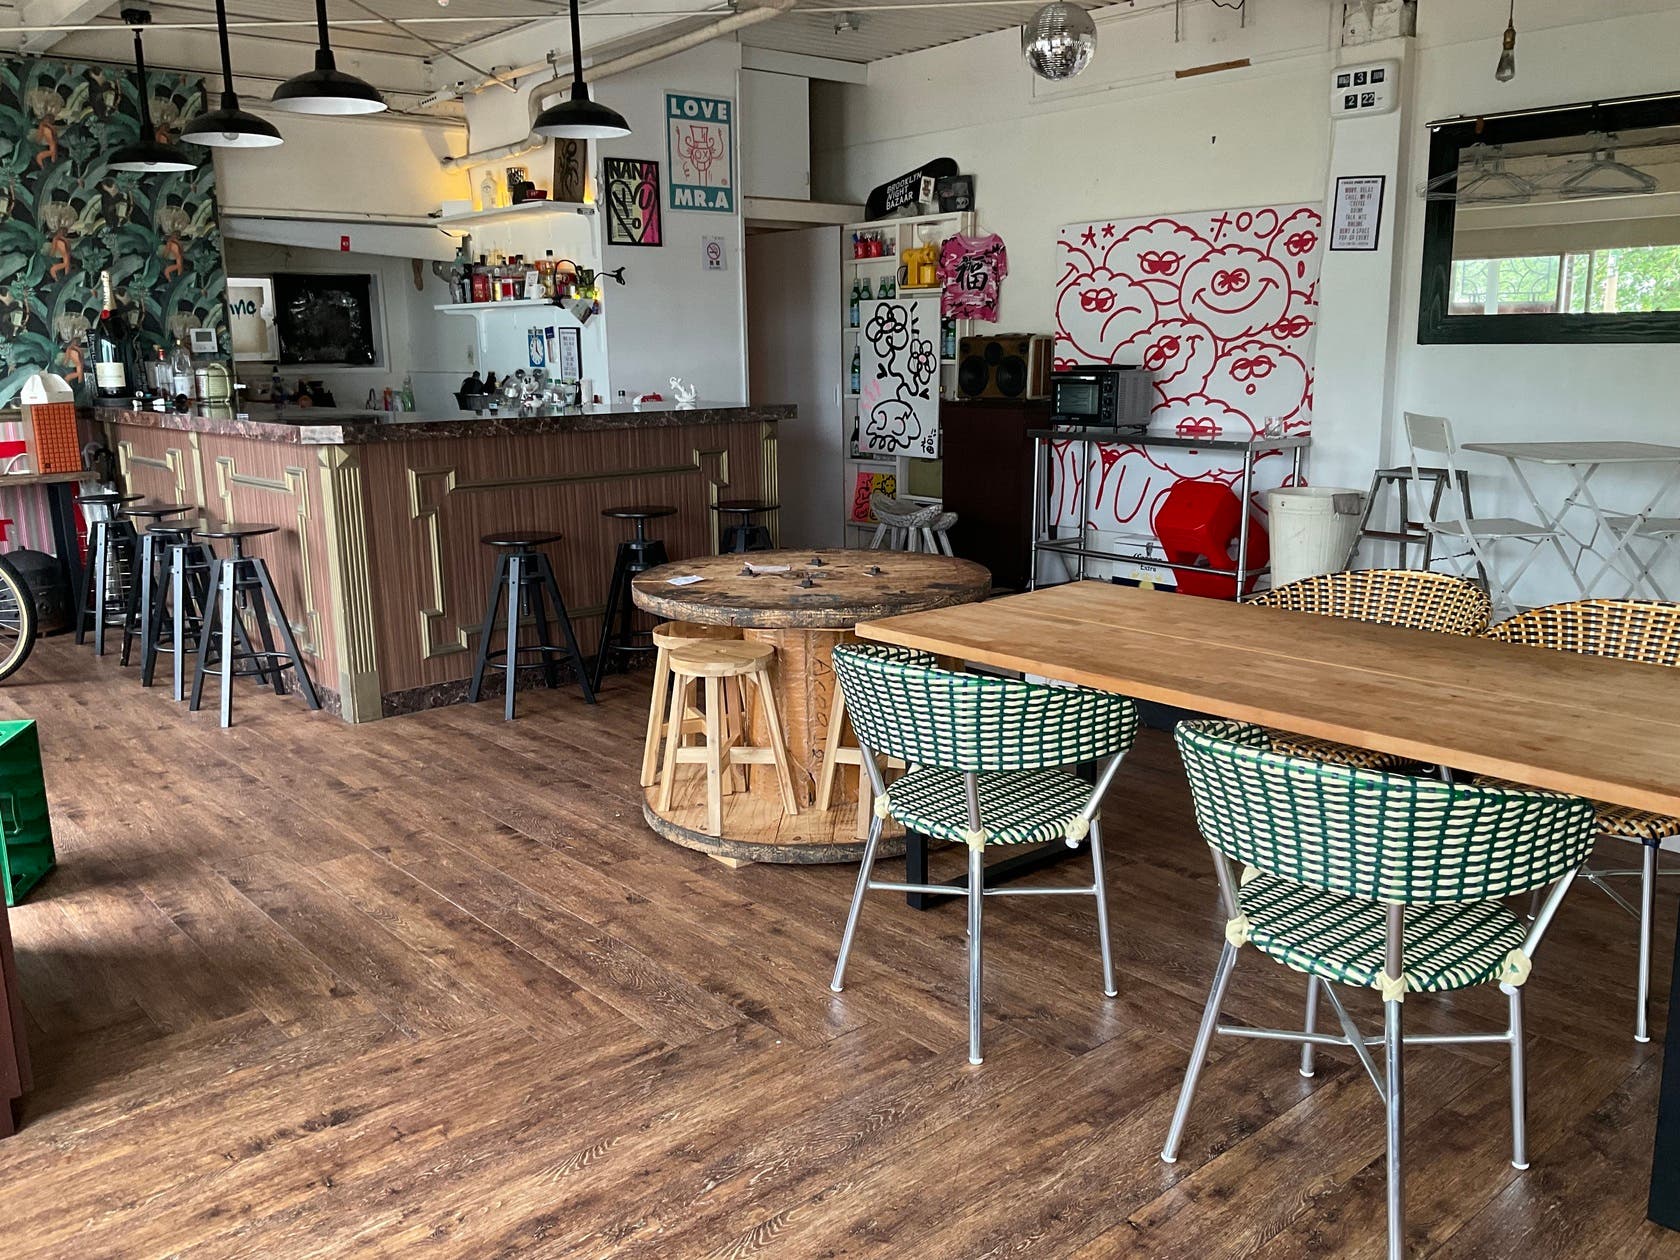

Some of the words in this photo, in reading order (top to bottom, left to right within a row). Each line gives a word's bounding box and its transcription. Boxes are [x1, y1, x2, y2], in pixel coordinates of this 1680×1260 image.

[1357, 72, 1364, 83] 3
[671, 98, 727, 120] LOVE
[1348, 95, 1355, 106] 2
[1362, 93, 1375, 104] 22
[887, 171, 922, 194] BROOKLYN
[675, 188, 729, 208] MR.A
[886, 191, 913, 210] BAZAAR
[887, 185, 908, 201] NIGHT
